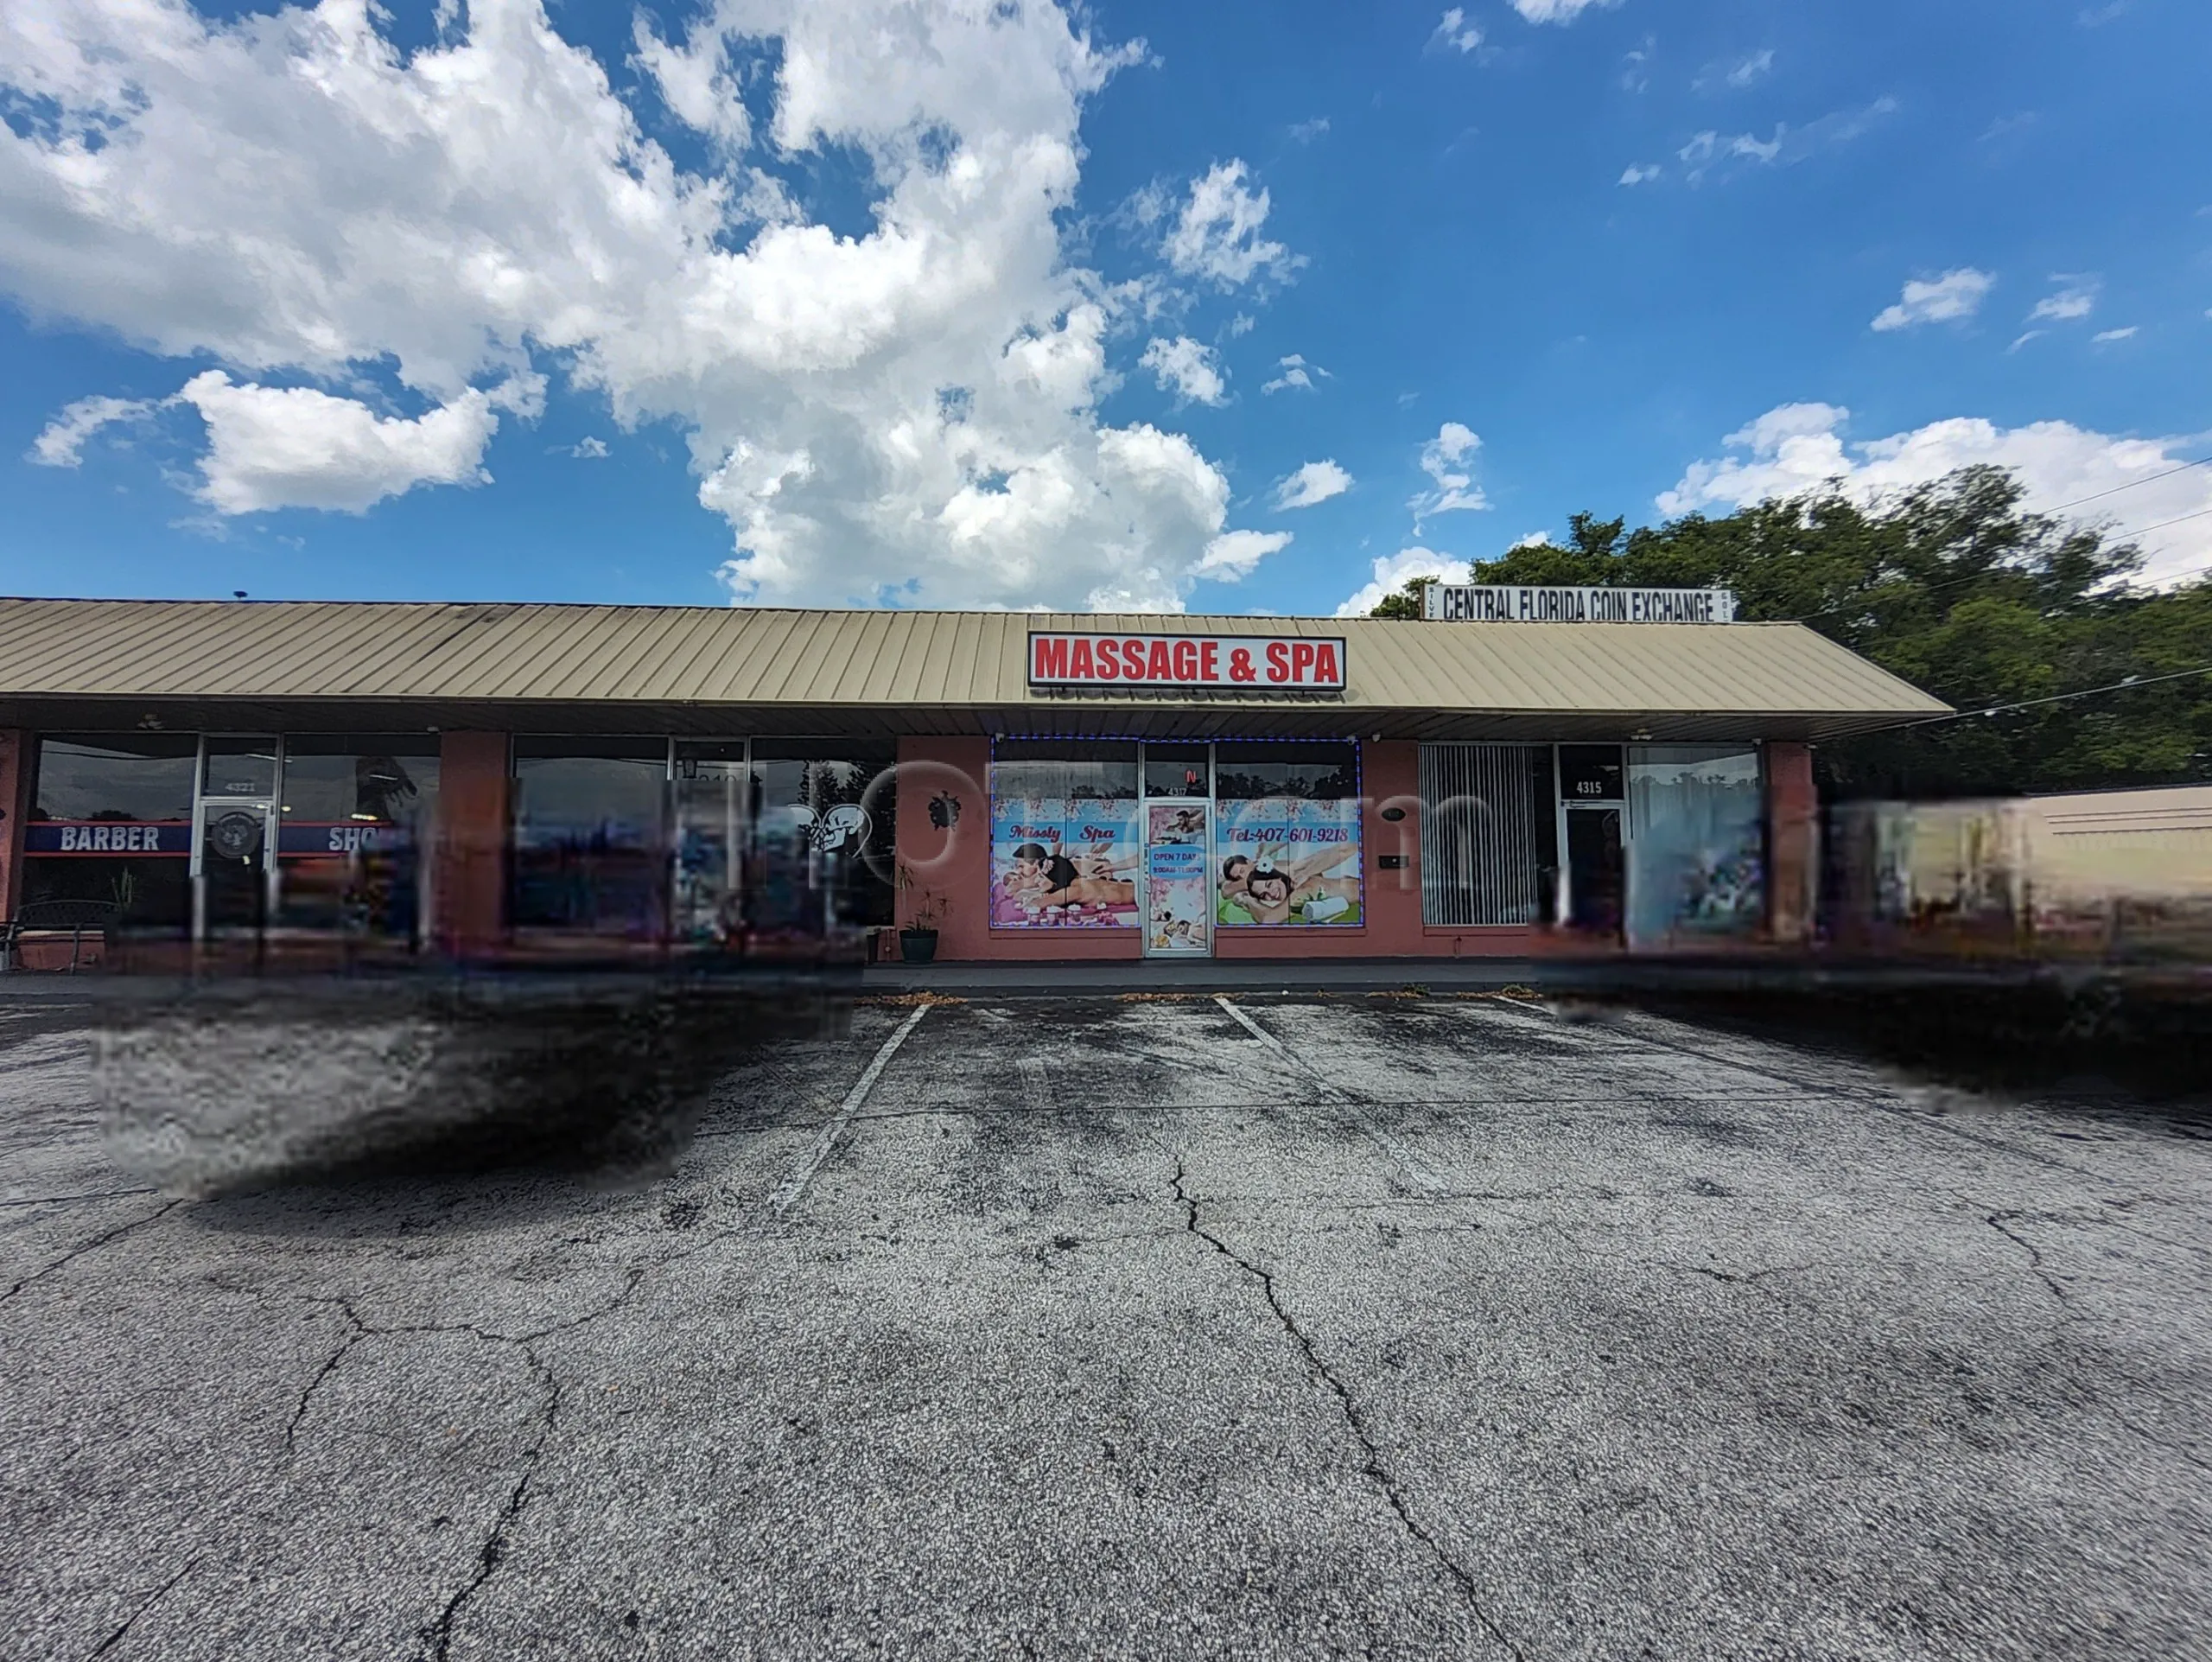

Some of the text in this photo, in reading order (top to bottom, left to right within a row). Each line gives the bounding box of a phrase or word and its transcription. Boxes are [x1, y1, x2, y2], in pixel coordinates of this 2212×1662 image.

[1444, 588, 1714, 621] CENTRAL FLORIDA COIN EXCHANGE
[1035, 639, 1338, 683] MASSAGE & SPA
[1186, 770, 1196, 783] N
[1168, 787, 1187, 796] 4317
[1577, 781, 1602, 794] 4315
[60, 826, 159, 851] BARBER
[1079, 825, 1116, 843] Spa
